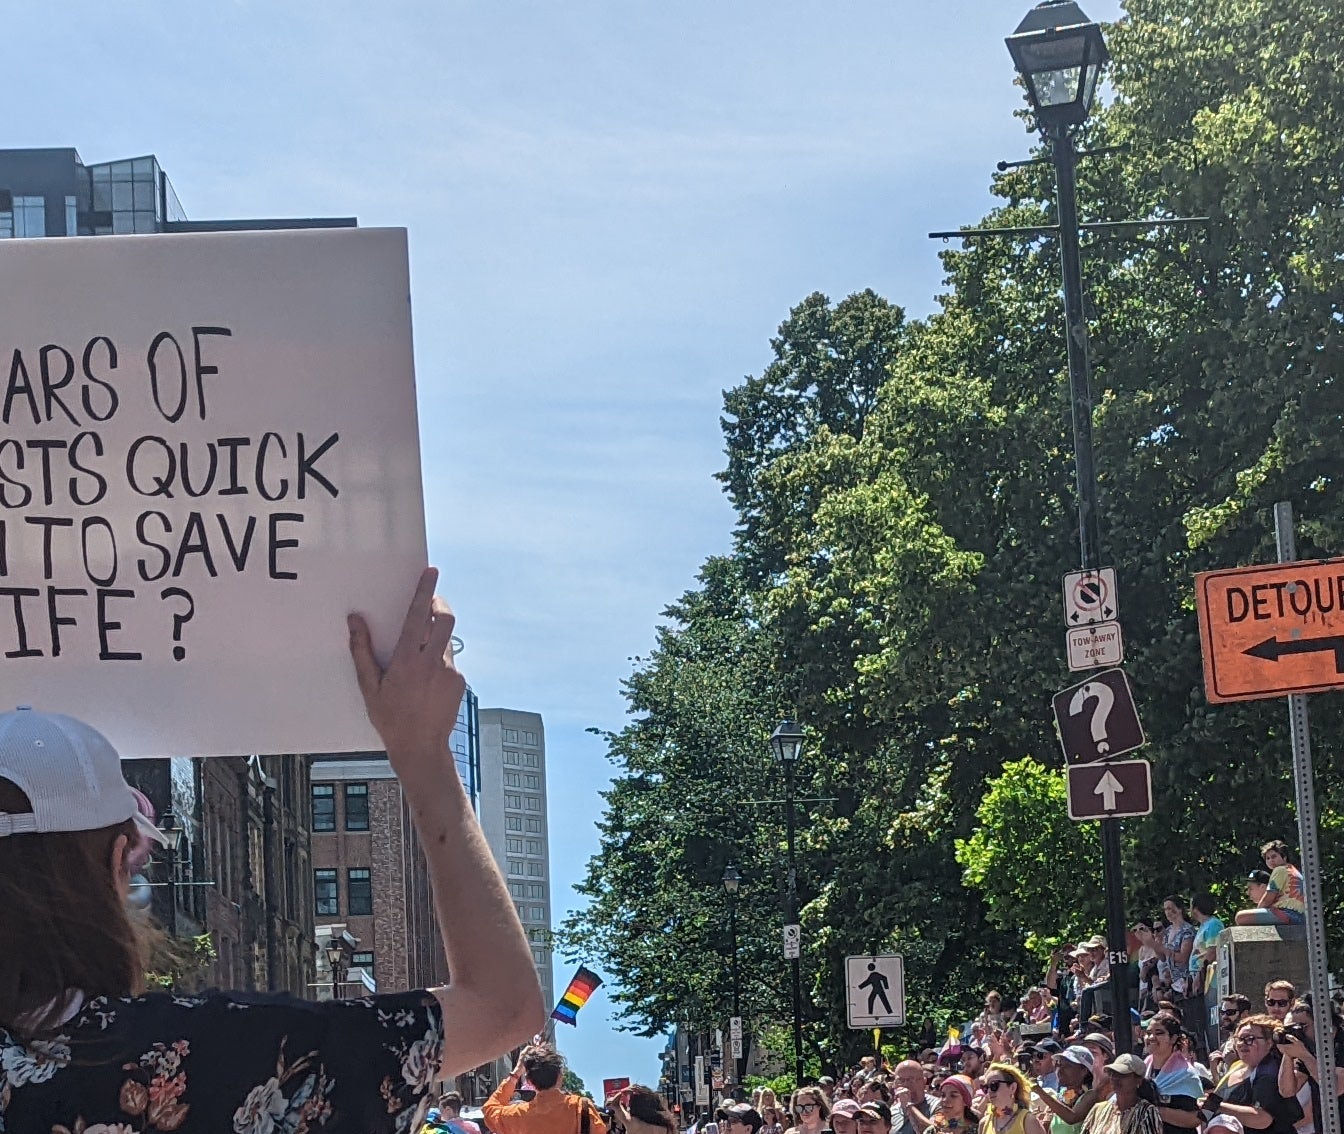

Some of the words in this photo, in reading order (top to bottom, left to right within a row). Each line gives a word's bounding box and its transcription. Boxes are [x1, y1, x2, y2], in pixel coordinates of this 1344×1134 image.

[147, 325, 233, 424] OF
[125, 432, 340, 501] QUICK
[24, 514, 119, 586] TO
[136, 510, 305, 583] SAVE
[1072, 632, 1116, 647] TOW-AWAY
[1084, 646, 1106, 659] ZONE
[1109, 950, 1128, 965] E15
